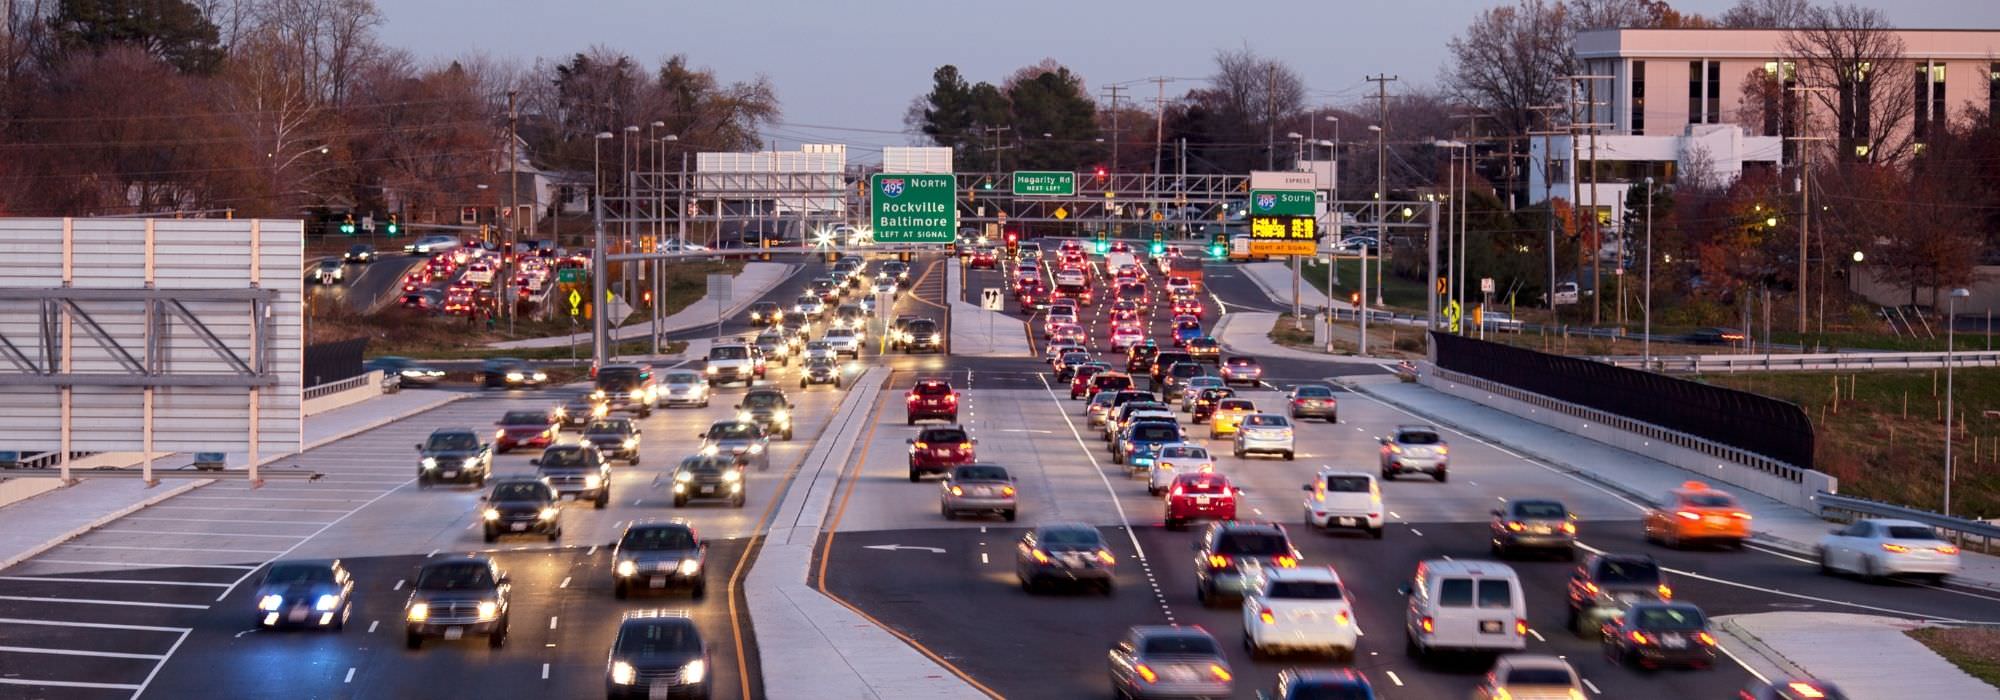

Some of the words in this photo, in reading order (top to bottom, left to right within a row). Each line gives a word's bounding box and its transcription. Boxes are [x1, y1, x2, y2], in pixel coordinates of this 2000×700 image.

[1017, 176, 1055, 185] Magarity
[884, 183, 902, 194] 495
[911, 178, 947, 187] NORTH
[1281, 194, 1310, 202] SOUTH
[882, 202, 945, 212] Rockville
[880, 216, 947, 227] Baltimore
